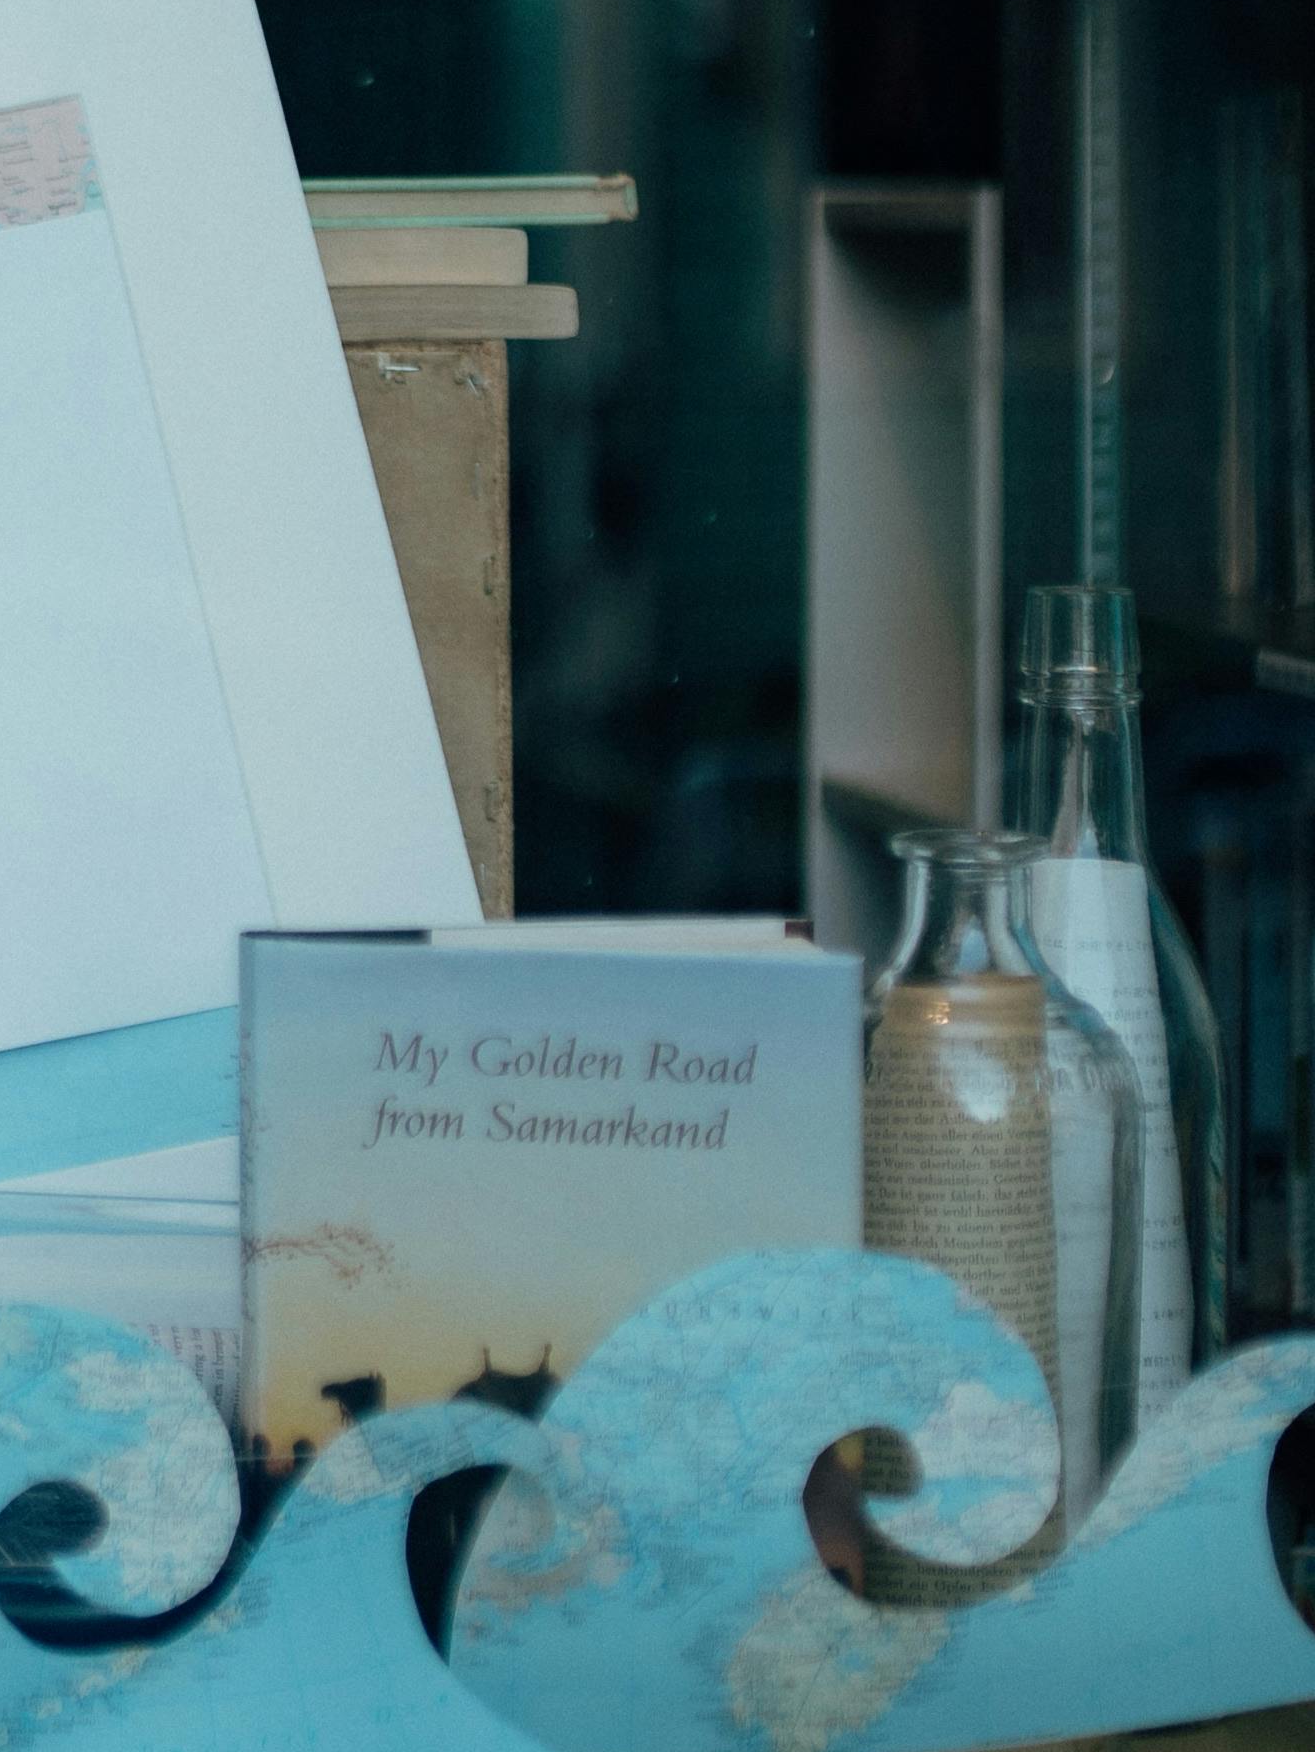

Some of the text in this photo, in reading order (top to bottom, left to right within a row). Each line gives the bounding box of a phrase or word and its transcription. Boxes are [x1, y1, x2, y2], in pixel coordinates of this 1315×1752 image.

[375, 1032, 757, 1085] My Golden Road
[371, 1098, 729, 1149] from Samarkand
